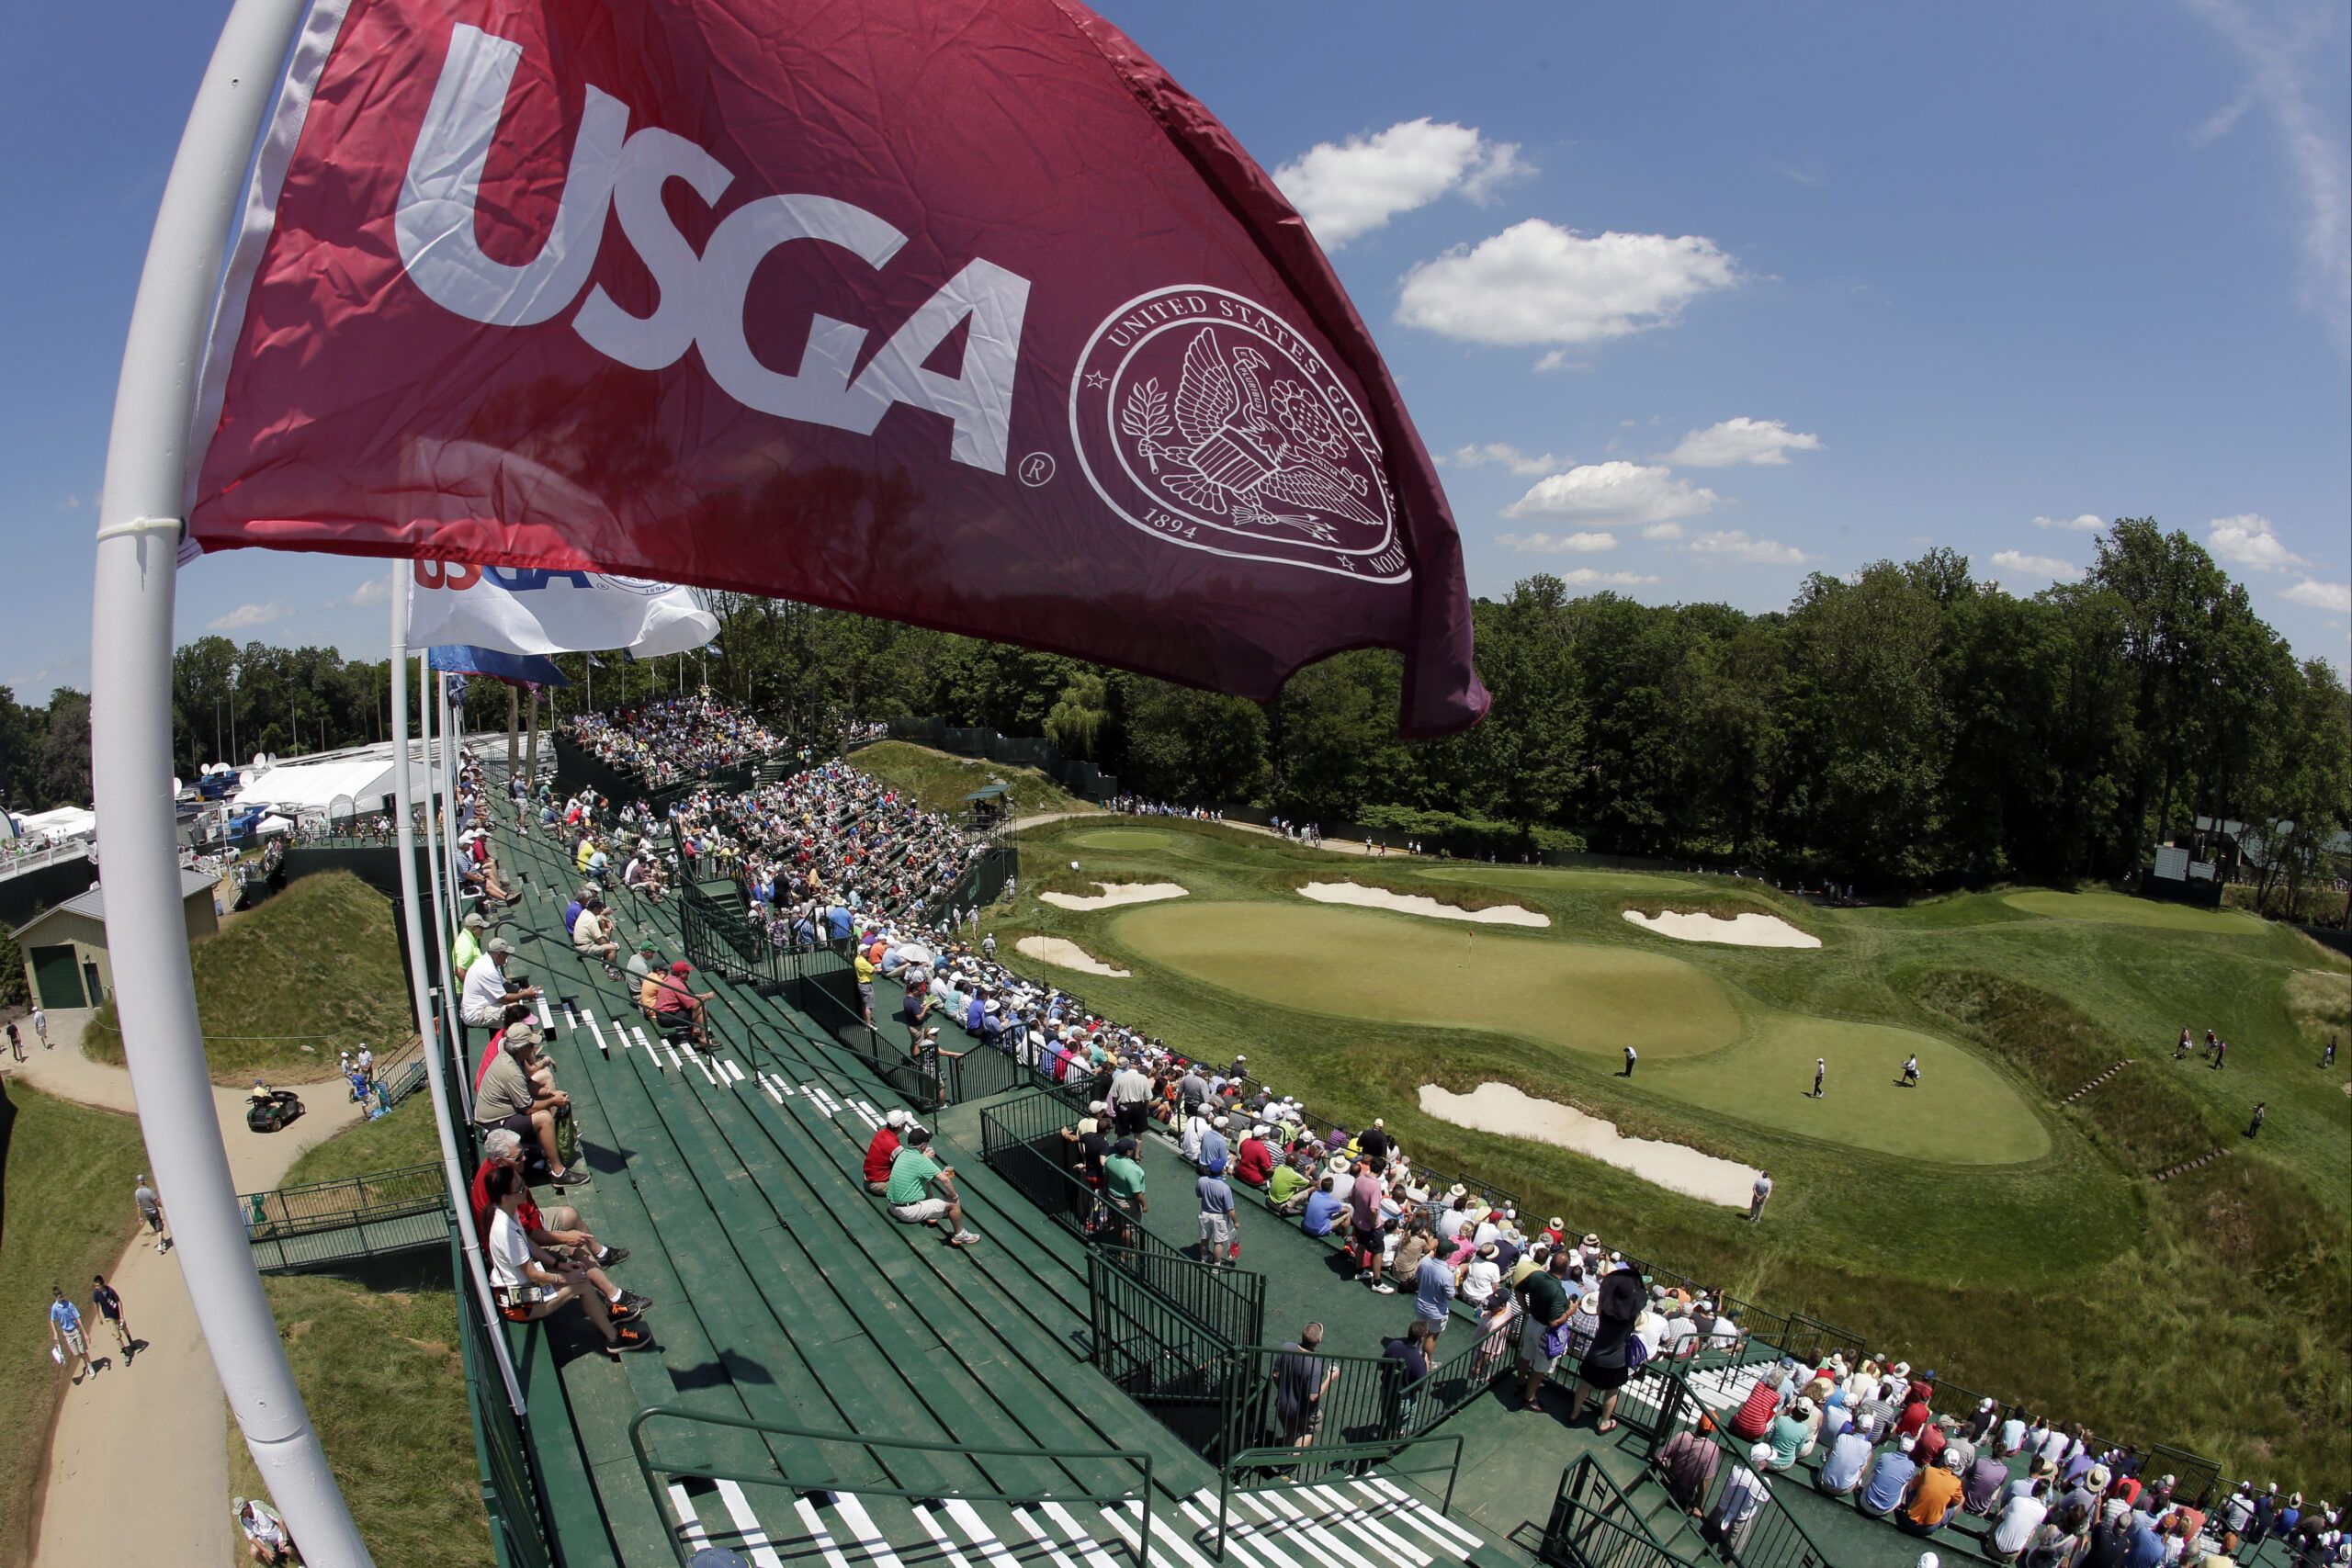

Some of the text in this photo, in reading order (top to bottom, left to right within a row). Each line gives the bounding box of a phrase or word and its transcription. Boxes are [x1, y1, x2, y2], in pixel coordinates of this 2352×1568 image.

[393, 22, 1032, 476] USGA
[1107, 296, 1207, 347] UNITED
[1219, 299, 1320, 375] STATES
[1328, 385, 1381, 462] GOLF
[1238, 367, 1263, 411] PLURIBUS
[1311, 457, 1339, 477] UNUM
[1143, 507, 1197, 539] 1894
